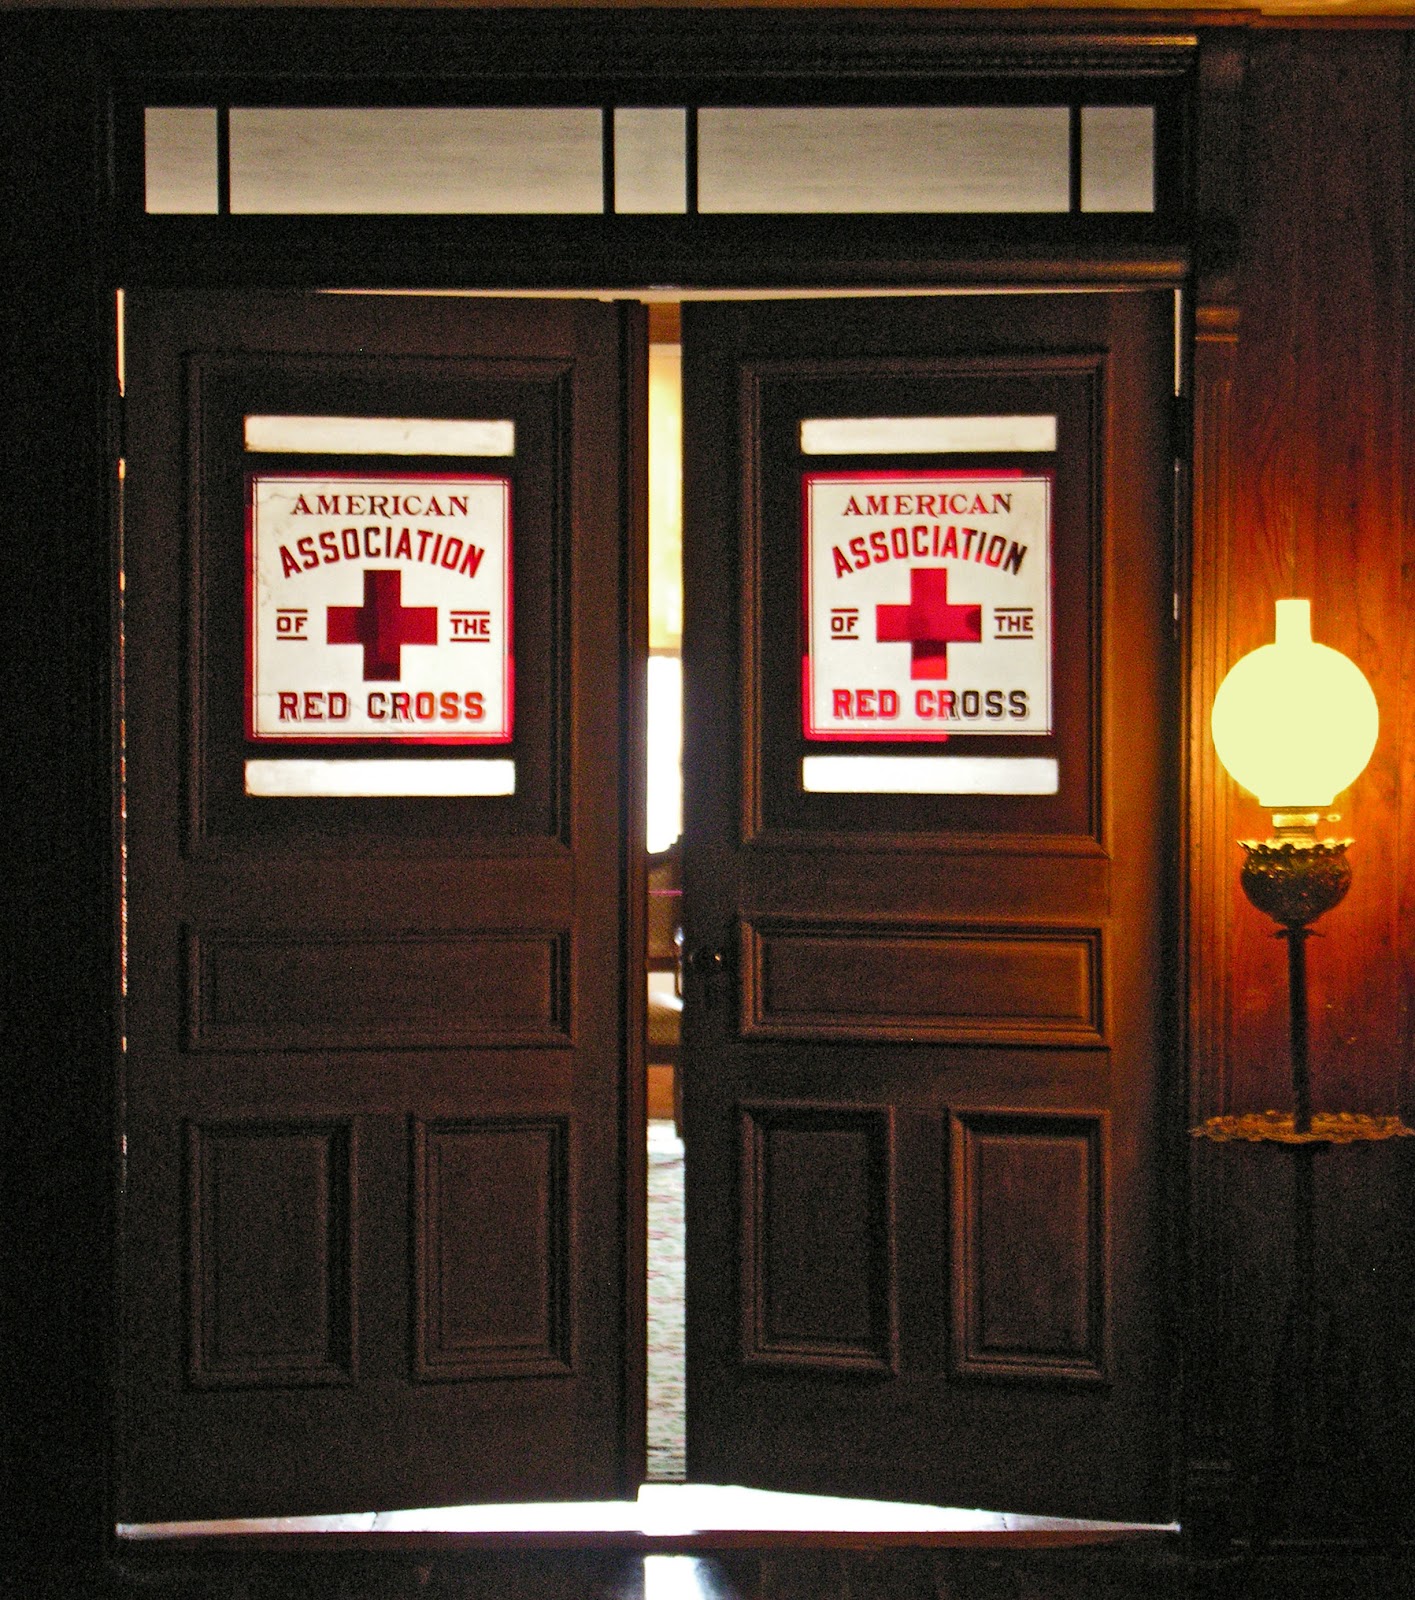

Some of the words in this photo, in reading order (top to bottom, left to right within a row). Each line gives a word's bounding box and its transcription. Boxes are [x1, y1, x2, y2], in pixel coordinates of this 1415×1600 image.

[290, 493, 469, 518] AMERICAN
[843, 493, 1013, 518] AMERICAN
[279, 526, 485, 579] ASSOCIATION
[832, 525, 1028, 579] ASSOCIATION
[276, 616, 308, 633] OF
[450, 618, 490, 635] THE
[830, 616, 859, 633] OF
[994, 615, 1034, 632] THE
[278, 691, 350, 722] RED
[367, 691, 486, 722] CROSS
[832, 689, 899, 720] RED
[915, 690, 1029, 721] CROSS
